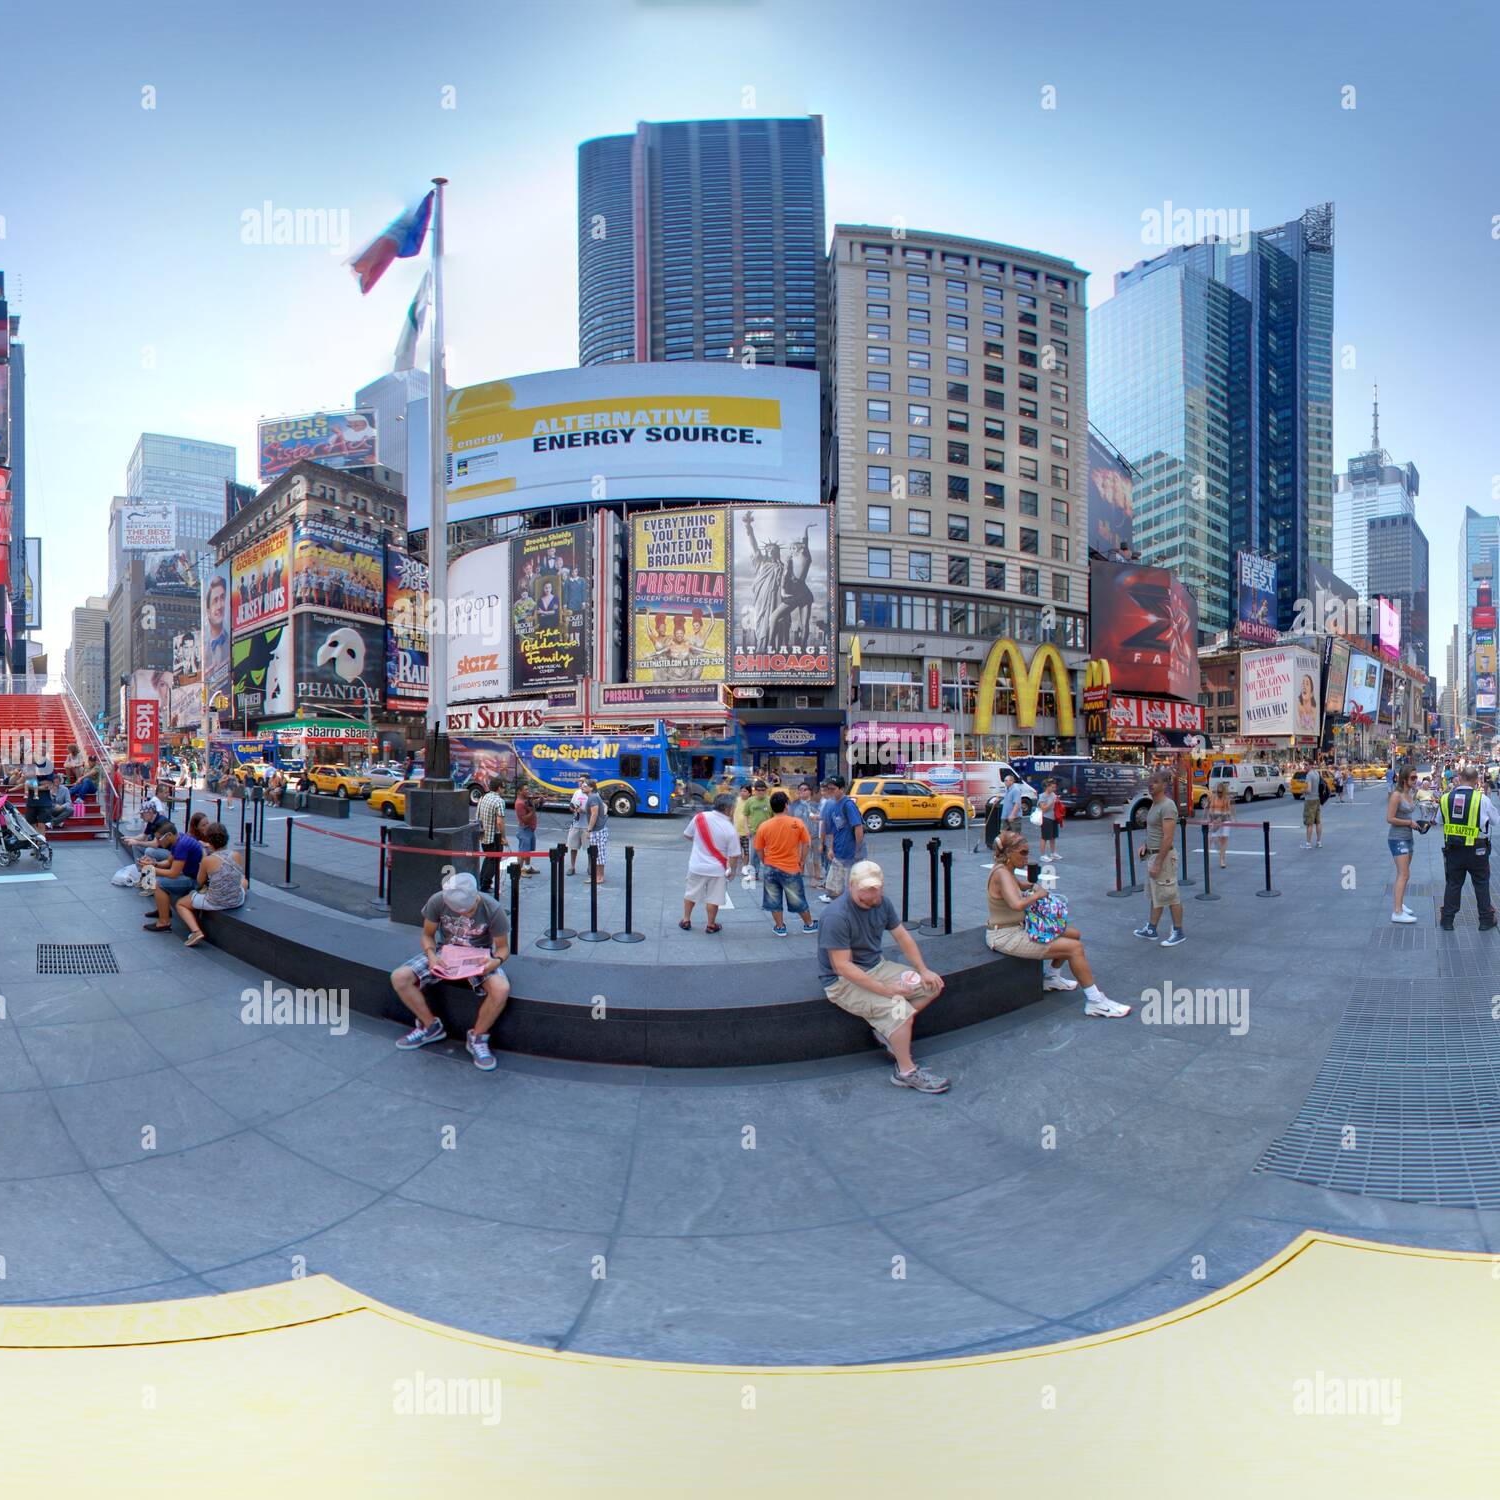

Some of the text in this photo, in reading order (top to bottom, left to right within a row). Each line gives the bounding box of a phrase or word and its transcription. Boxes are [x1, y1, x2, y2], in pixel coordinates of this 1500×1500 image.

[264, 416, 328, 434] NUNS
[532, 408, 710, 435] ALTERNATIVE
[264, 428, 328, 444] ROCK!
[457, 432, 504, 449] energy
[532, 426, 762, 454] ENERGY SOURCE.
[264, 440, 312, 466] Sister
[644, 514, 716, 532] EVERYTHING
[526, 530, 572, 546] Brooke Shields
[652, 527, 706, 542] YOU EVER
[236, 529, 287, 565] THE CROWD
[523, 544, 537, 555] joins
[537, 542, 550, 550] the
[646, 538, 712, 556] WANTED ON
[236, 557, 258, 572] GOES
[647, 552, 712, 568] BROADWAY!
[636, 572, 724, 597] PRISCILLA
[1242, 566, 1275, 586] BEST
[236, 586, 286, 626] JERSEY BOYS
[534, 628, 560, 640] The
[1240, 622, 1277, 642] MEMPHIS
[520, 639, 578, 654] Addams
[734, 646, 828, 654] AT LARGE
[456, 653, 500, 676] starz
[526, 651, 574, 669] Family
[734, 654, 829, 672] CHICAGO
[1256, 666, 1276, 678] KNOW
[1268, 674, 1290, 688] GONNA
[296, 682, 380, 702] PHANTOM
[604, 688, 644, 702] PRISCILLA
[738, 688, 759, 696] FUEL
[1256, 689, 1270, 700] LOVE
[477, 705, 544, 730] SUITES
[1246, 702, 1288, 720] MAMMA MIA!
[136, 703, 154, 740] tkts
[306, 724, 341, 738] sbarro
[532, 744, 620, 762] CitySights NY
[1456, 826, 1475, 836] SAFETY
